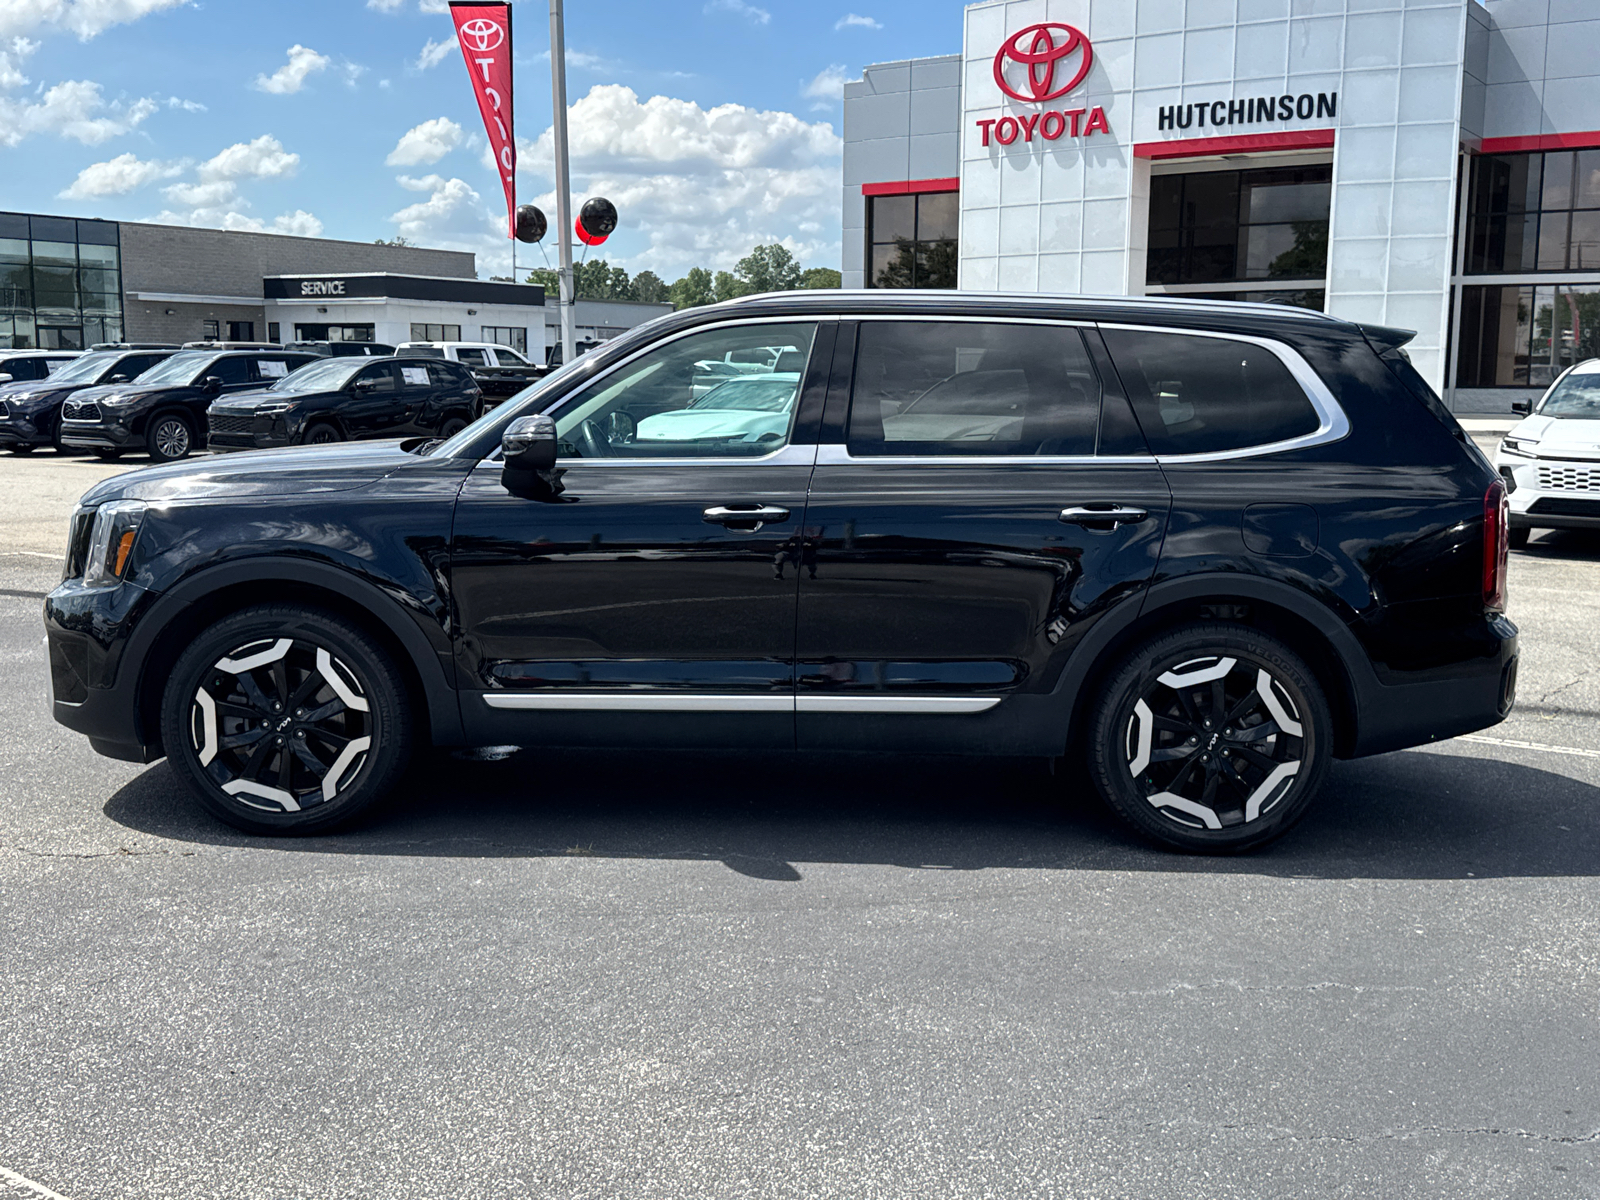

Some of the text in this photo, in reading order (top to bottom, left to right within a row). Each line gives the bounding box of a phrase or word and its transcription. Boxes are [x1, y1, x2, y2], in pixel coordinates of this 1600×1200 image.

[976, 106, 1110, 147] TOYOTA
[1159, 92, 1337, 131] HUTCHINSON
[301, 281, 346, 295] SERVICE
[1247, 643, 1307, 688] VELOCITY
